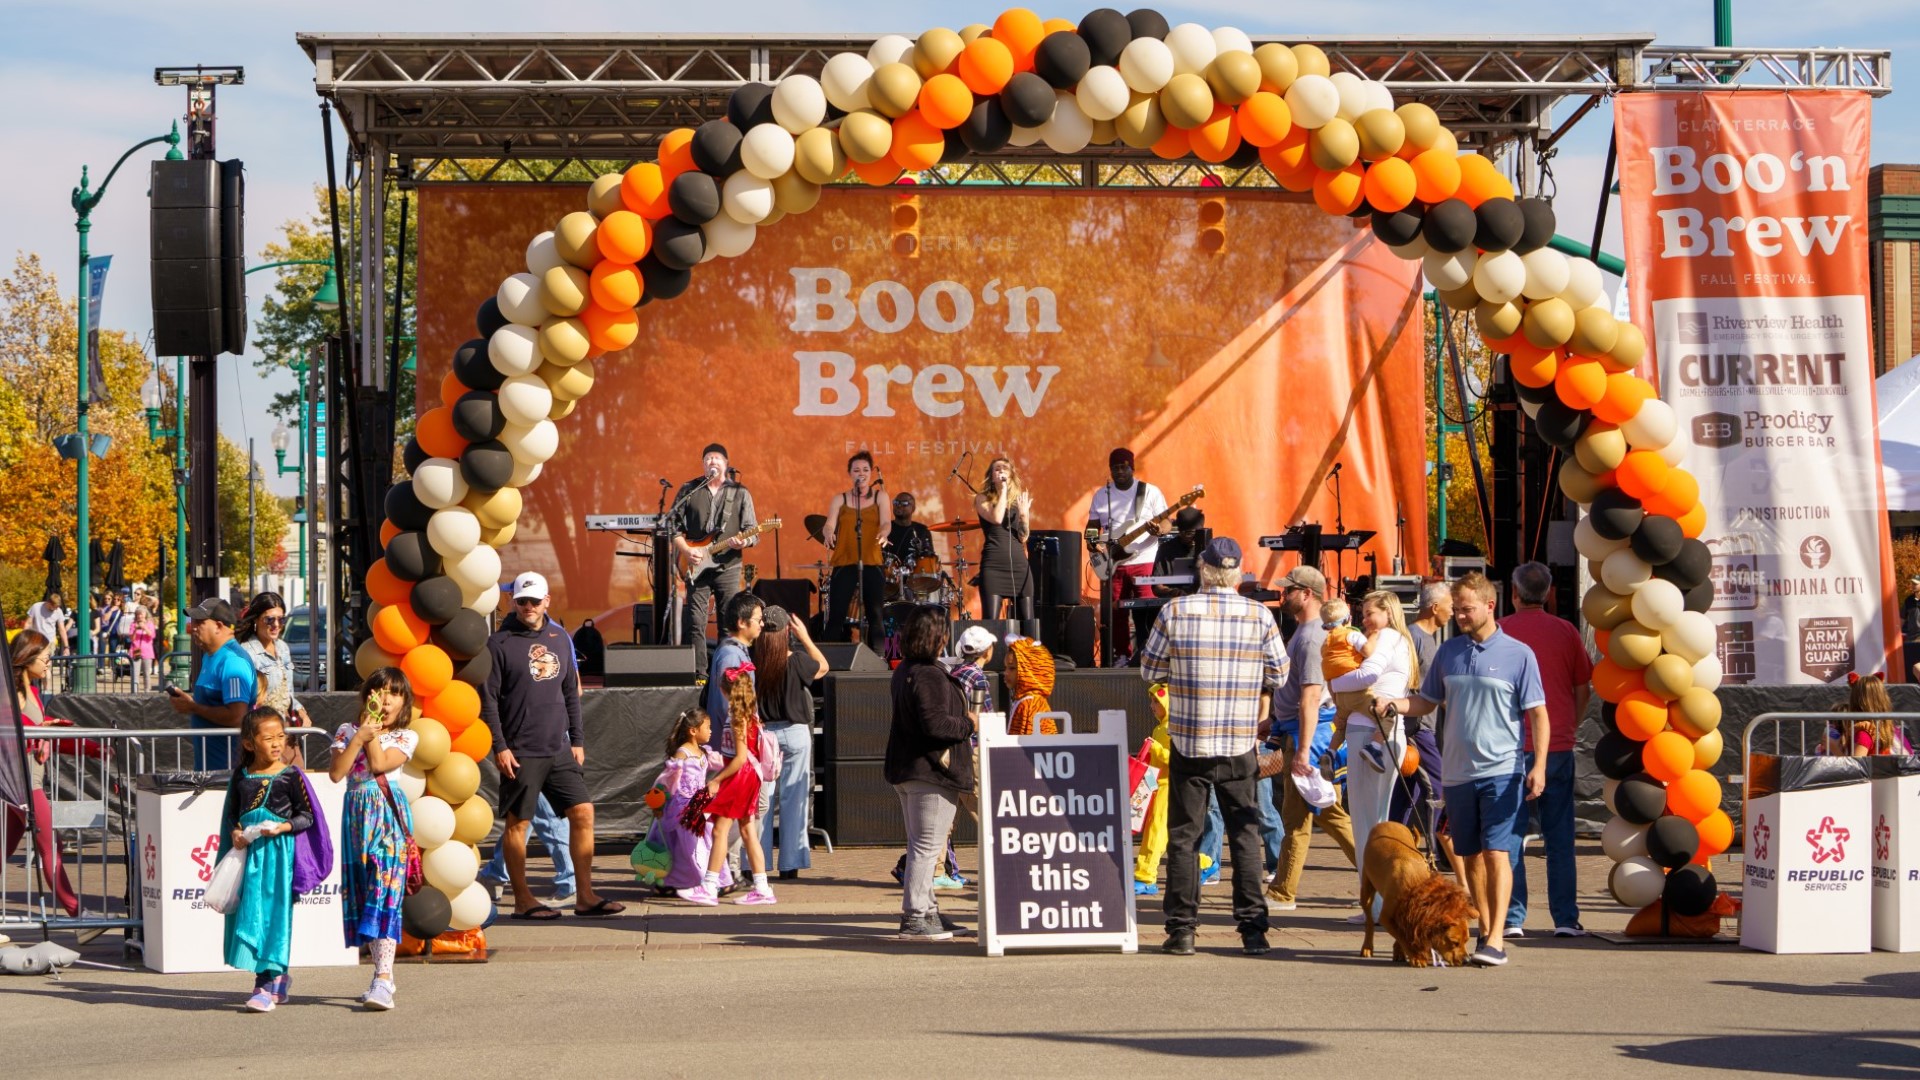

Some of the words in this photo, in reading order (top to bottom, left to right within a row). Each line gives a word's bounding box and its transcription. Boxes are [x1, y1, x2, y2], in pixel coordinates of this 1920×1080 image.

[1678, 119, 1723, 133] CLAY
[1733, 117, 1816, 132] TERRACE
[1657, 207, 1851, 259] Brew
[831, 235, 893, 251] CLAY
[906, 235, 1019, 251] TERRACE
[1700, 274, 1736, 285] FALL
[1743, 273, 1816, 285] FESTIVAL
[1712, 314, 1788, 330] Riverview
[1790, 313, 1844, 330] Health
[1678, 352, 1846, 388] CURRENT
[792, 351, 1062, 418] Brew
[1744, 410, 1834, 434] Prodigy
[845, 440, 895, 455] FALL
[906, 440, 1007, 455] FESTIVAL
[1745, 436, 1804, 448] BURGER
[1808, 435, 1836, 447] BAR
[1739, 505, 1831, 520] CONSTRUCTION
[617, 517, 640, 526] KORG
[1767, 577, 1828, 597] INDIANA
[1834, 576, 1865, 595] CITY
[1813, 619, 1839, 627] INDIANA
[1805, 630, 1849, 643] ARMY
[1804, 642, 1849, 651] NATIONAL
[1805, 650, 1850, 663] GUARD
[1033, 751, 1075, 780] NO
[997, 788, 1115, 817] Alcohol
[1000, 825, 1115, 860] Beyond
[1029, 863, 1090, 891] this
[1745, 864, 1776, 881] REPUBLIC
[1787, 870, 1865, 882] REPUBLIC
[1871, 865, 1897, 881] EPUBLIC
[1804, 883, 1848, 892] SERVICES
[298, 896, 331, 905] RVICES
[1019, 901, 1104, 929] Point
